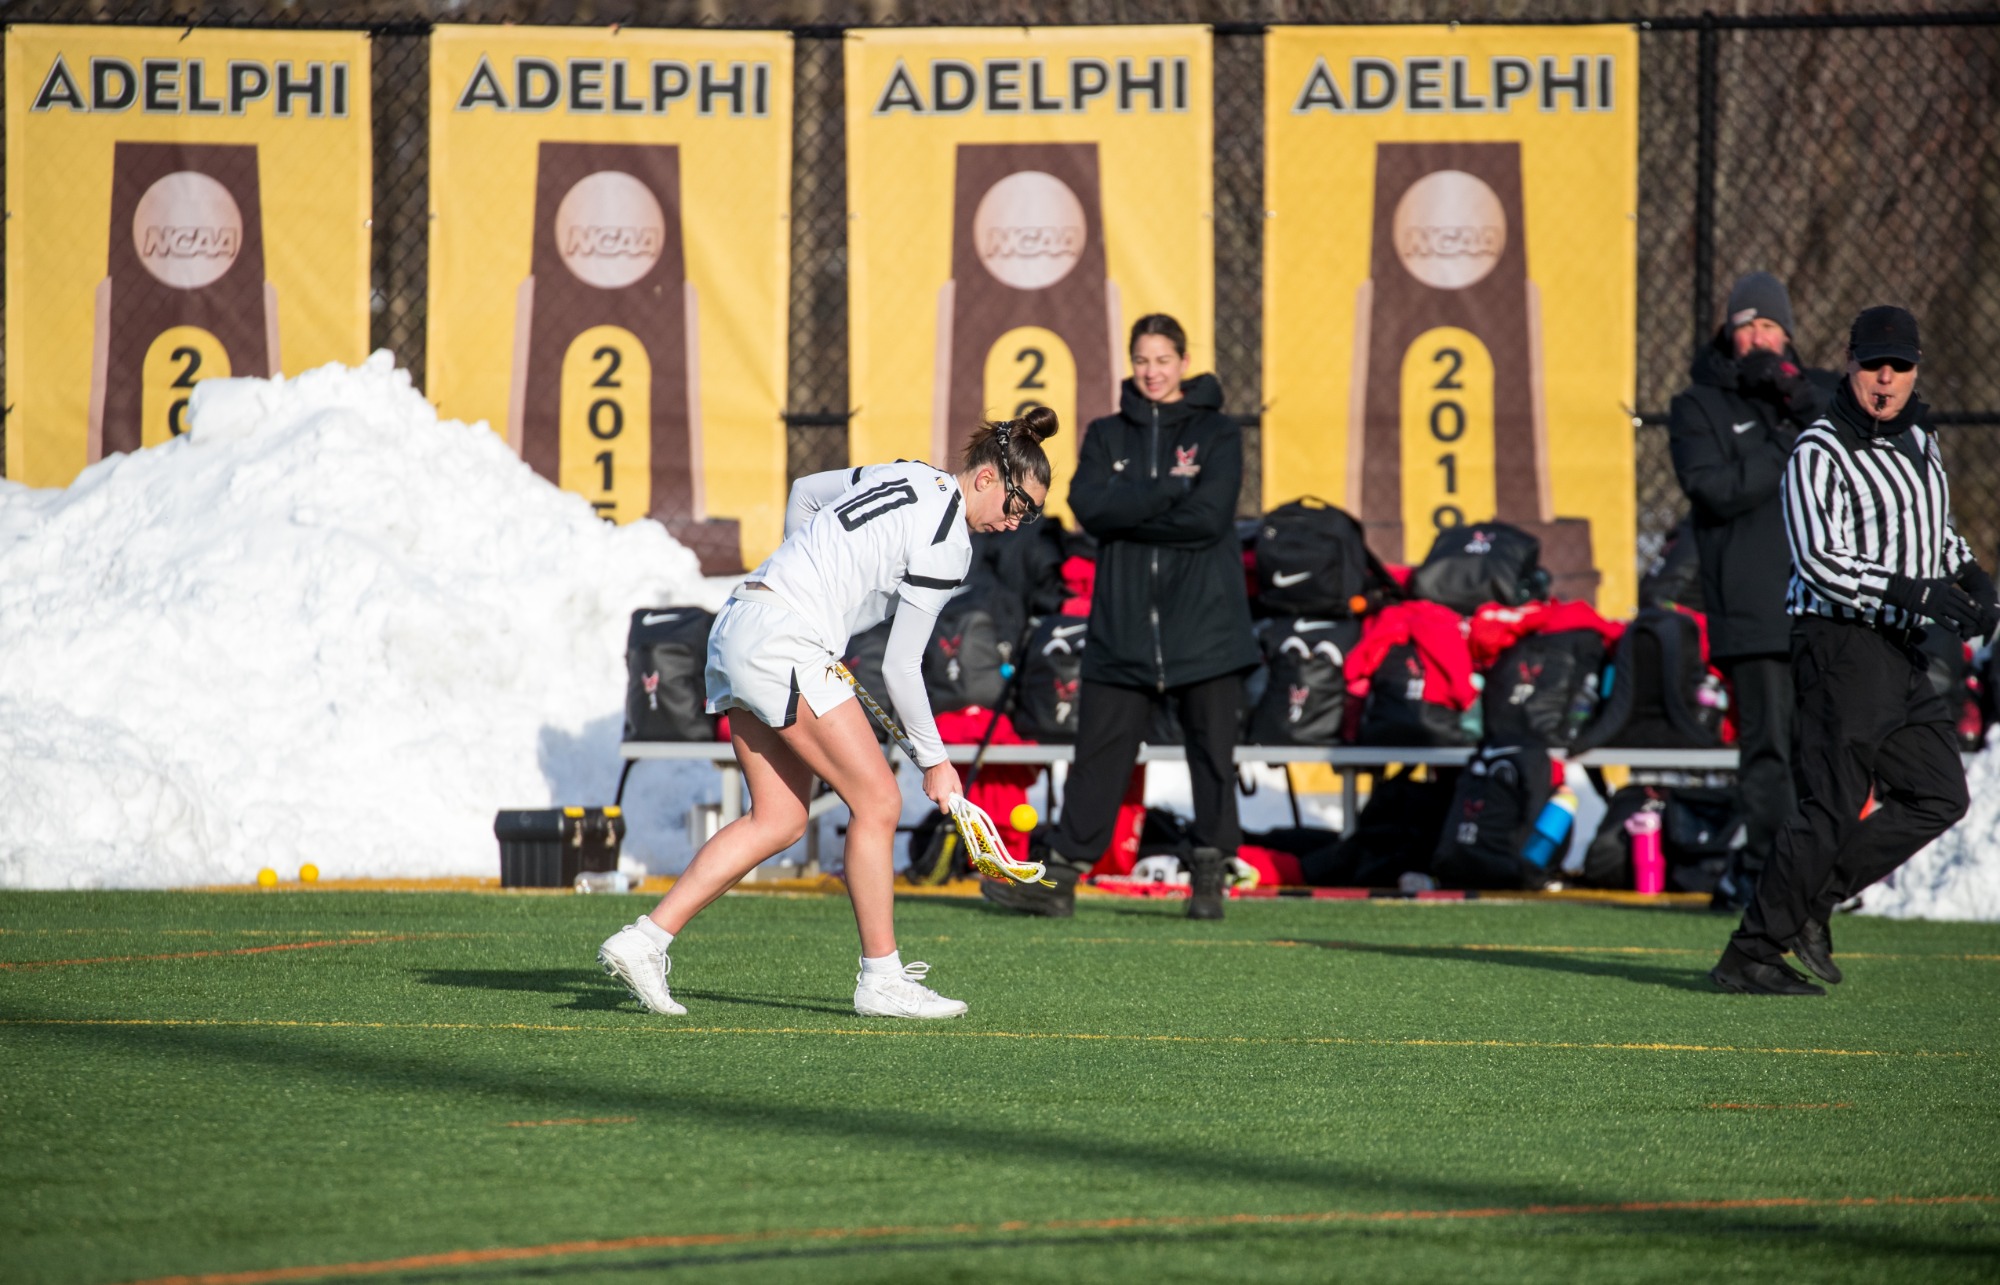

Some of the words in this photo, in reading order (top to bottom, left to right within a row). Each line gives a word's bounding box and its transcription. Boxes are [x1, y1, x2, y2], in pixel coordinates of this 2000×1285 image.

[31, 53, 349, 117] ADELPHI
[457, 53, 772, 117] ADELPHI
[873, 55, 1191, 116] ADELPHI
[1292, 54, 1616, 115] ADELPHI
[143, 225, 238, 258] NCAA
[565, 225, 661, 258] NCAA
[984, 225, 1081, 258] NCAA
[1402, 225, 1500, 258] NCAA
[833, 477, 919, 532] 10
